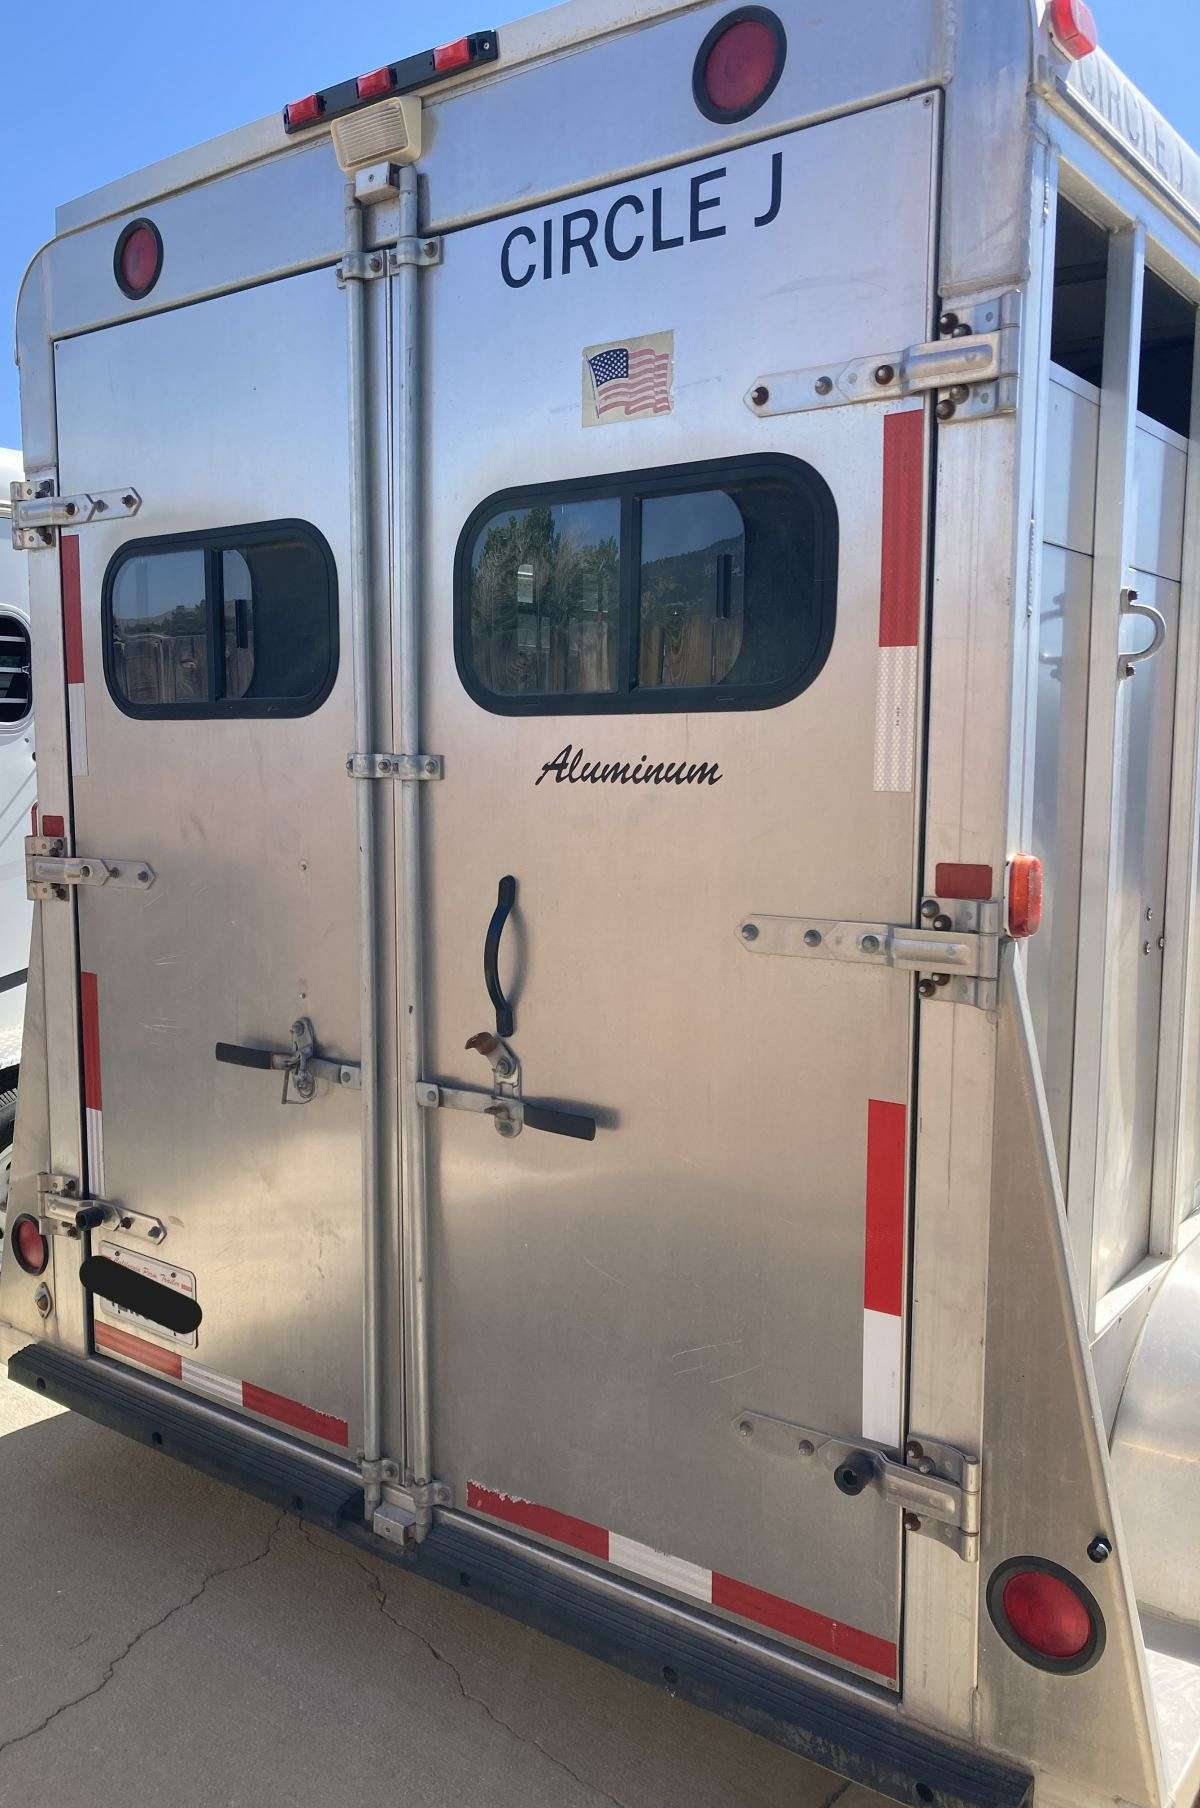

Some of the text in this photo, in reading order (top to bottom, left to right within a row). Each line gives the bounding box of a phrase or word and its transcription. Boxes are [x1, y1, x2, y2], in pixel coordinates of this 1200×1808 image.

[501, 152, 782, 288] CIRCLE J
[535, 744, 723, 785] Aluminum
